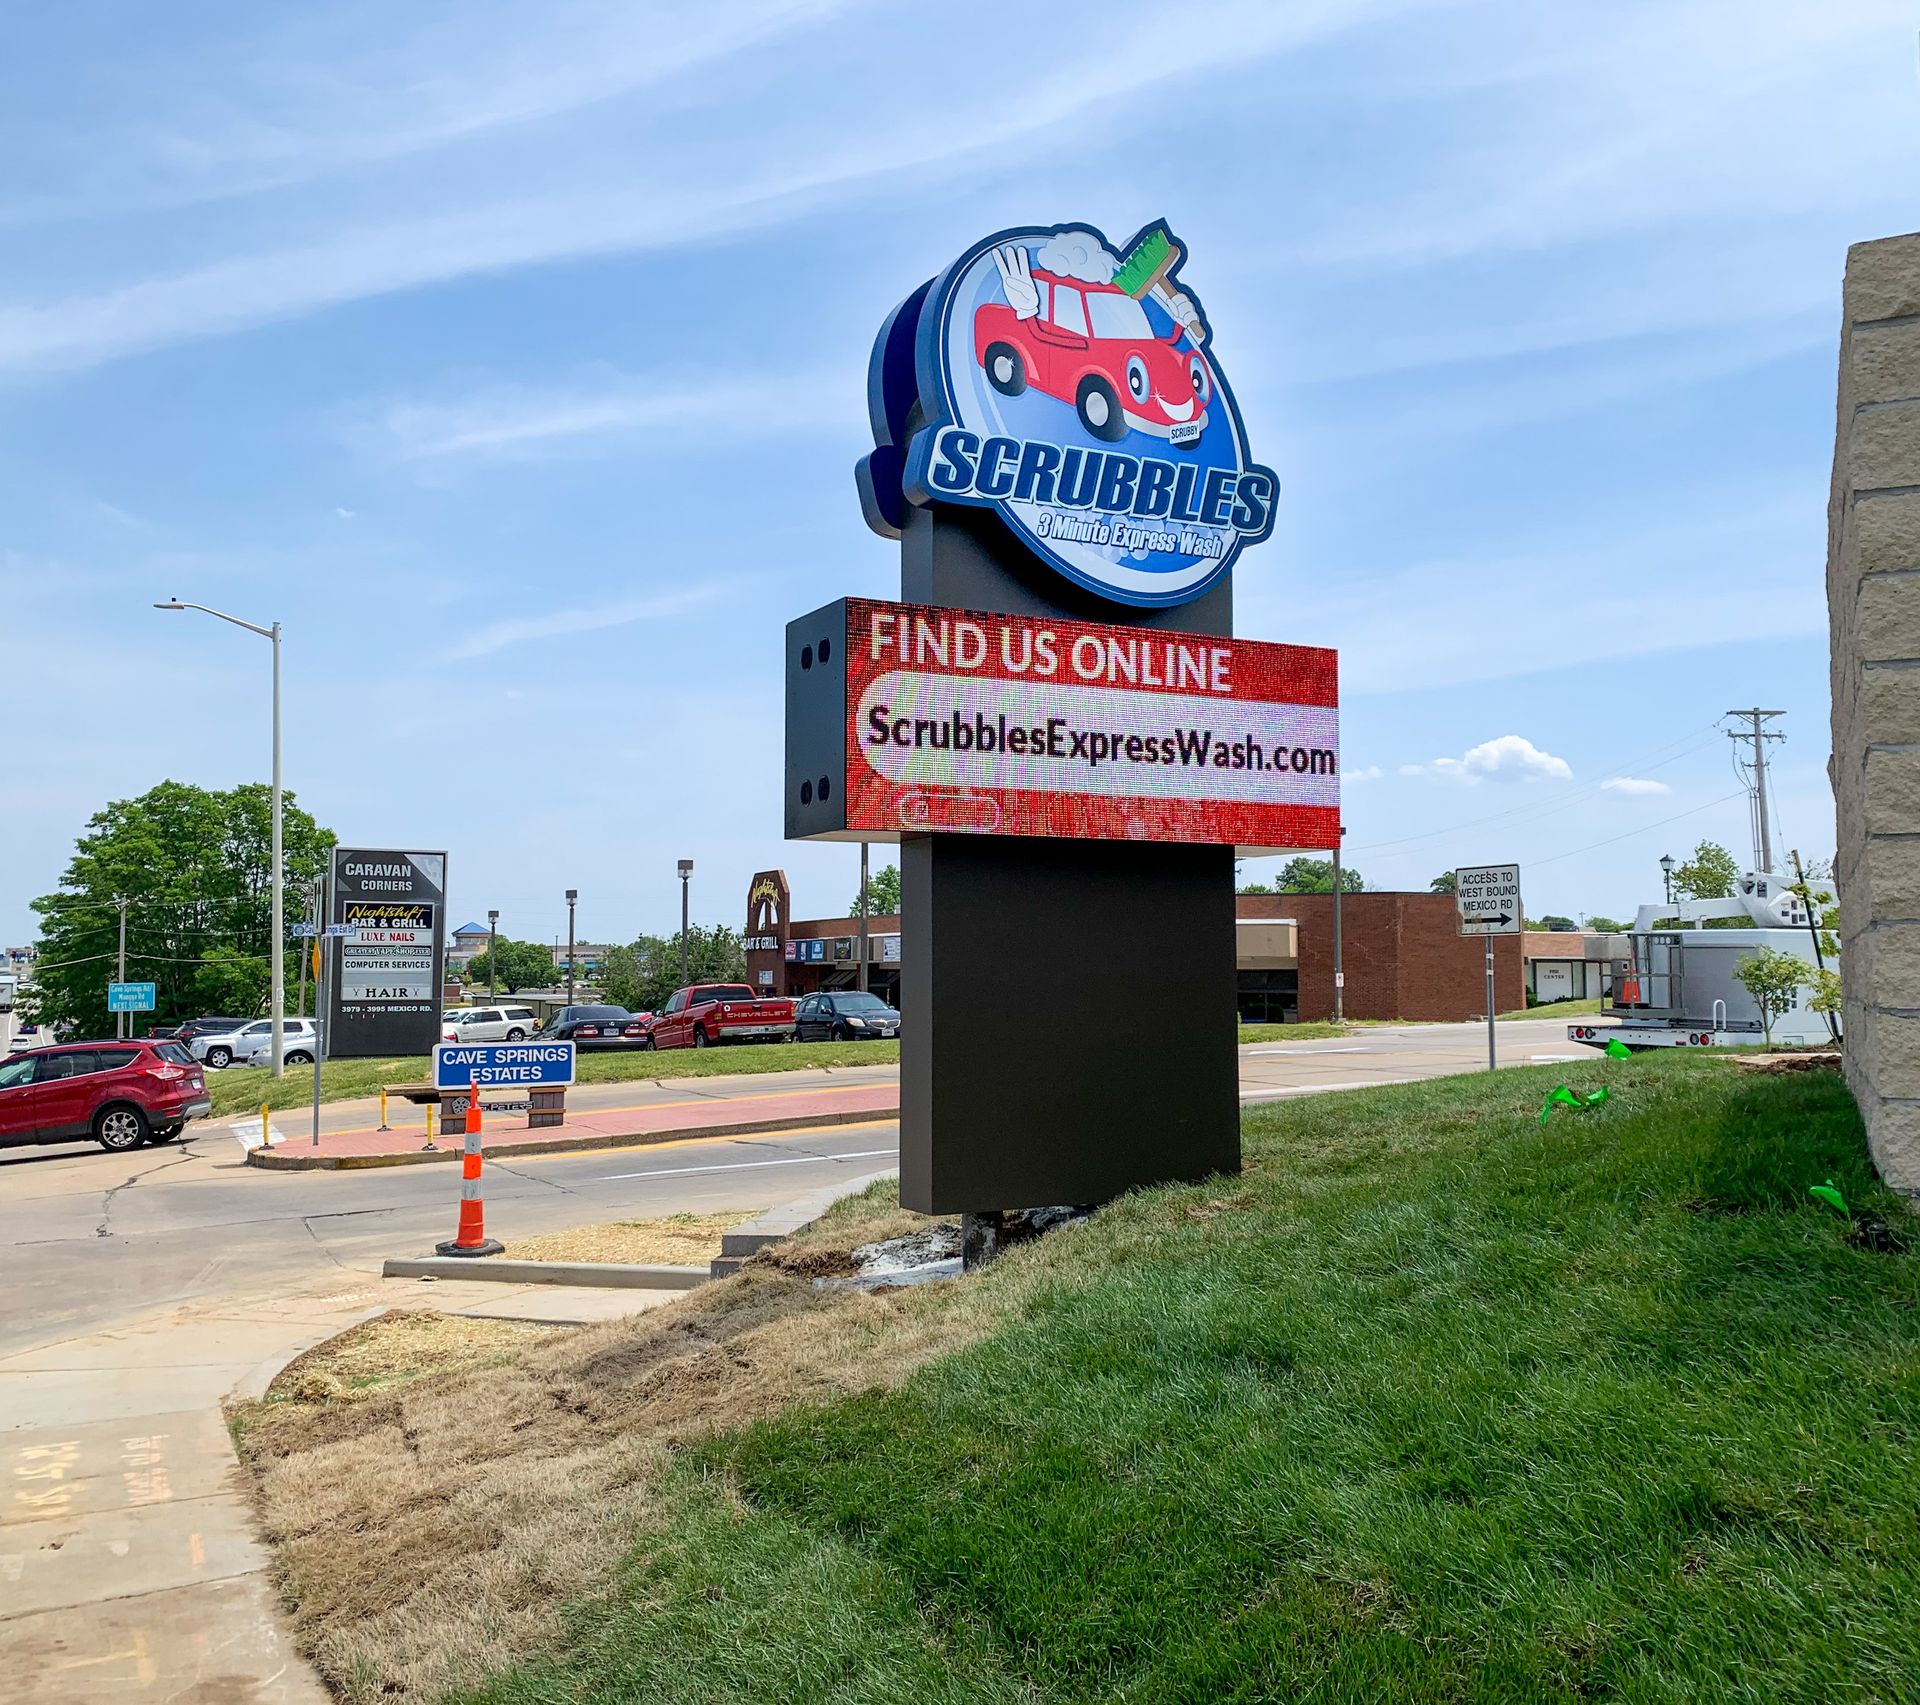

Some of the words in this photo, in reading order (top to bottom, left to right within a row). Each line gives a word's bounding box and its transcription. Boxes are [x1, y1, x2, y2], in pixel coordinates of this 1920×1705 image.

[1171, 425, 1198, 439] SCRUBBY
[930, 429, 1272, 531] SCRUBBLES
[1037, 513, 1052, 538] 3
[1052, 515, 1110, 544] Minute
[1111, 523, 1177, 552] Express
[1178, 531, 1222, 558] Wash
[870, 613, 987, 668] FIND
[1001, 628, 1058, 675] US
[1071, 635, 1233, 692] ONLINE
[867, 704, 1336, 776] ScrubblesExpressWash.com
[345, 863, 411, 877] CARAVAN
[1462, 872, 1498, 884] ACCESS
[1501, 871, 1513, 882] TO
[361, 880, 413, 891] CORNERS
[1459, 887, 1483, 898] WEST
[1486, 885, 1517, 897] BOUND
[348, 904, 430, 919] Nightshift
[1463, 900, 1497, 911] MEXICO
[1501, 899, 1513, 909] RD
[351, 918, 376, 928] BAR
[379, 918, 388, 928] &
[392, 918, 427, 928] GRILL
[361, 932, 385, 941] LUXE
[390, 932, 415, 941] NAILS
[743, 937, 755, 950] BAR
[761, 936, 778, 949] GRILL
[345, 961, 389, 969] COMPUTER
[391, 961, 431, 969] SERVICES
[366, 988, 408, 998] HAIR
[727, 1010, 787, 1018] CHEVROLET
[442, 1050, 488, 1065] CAVE
[495, 1047, 569, 1064] SPRINGS
[469, 1065, 543, 1082] ESTATES
